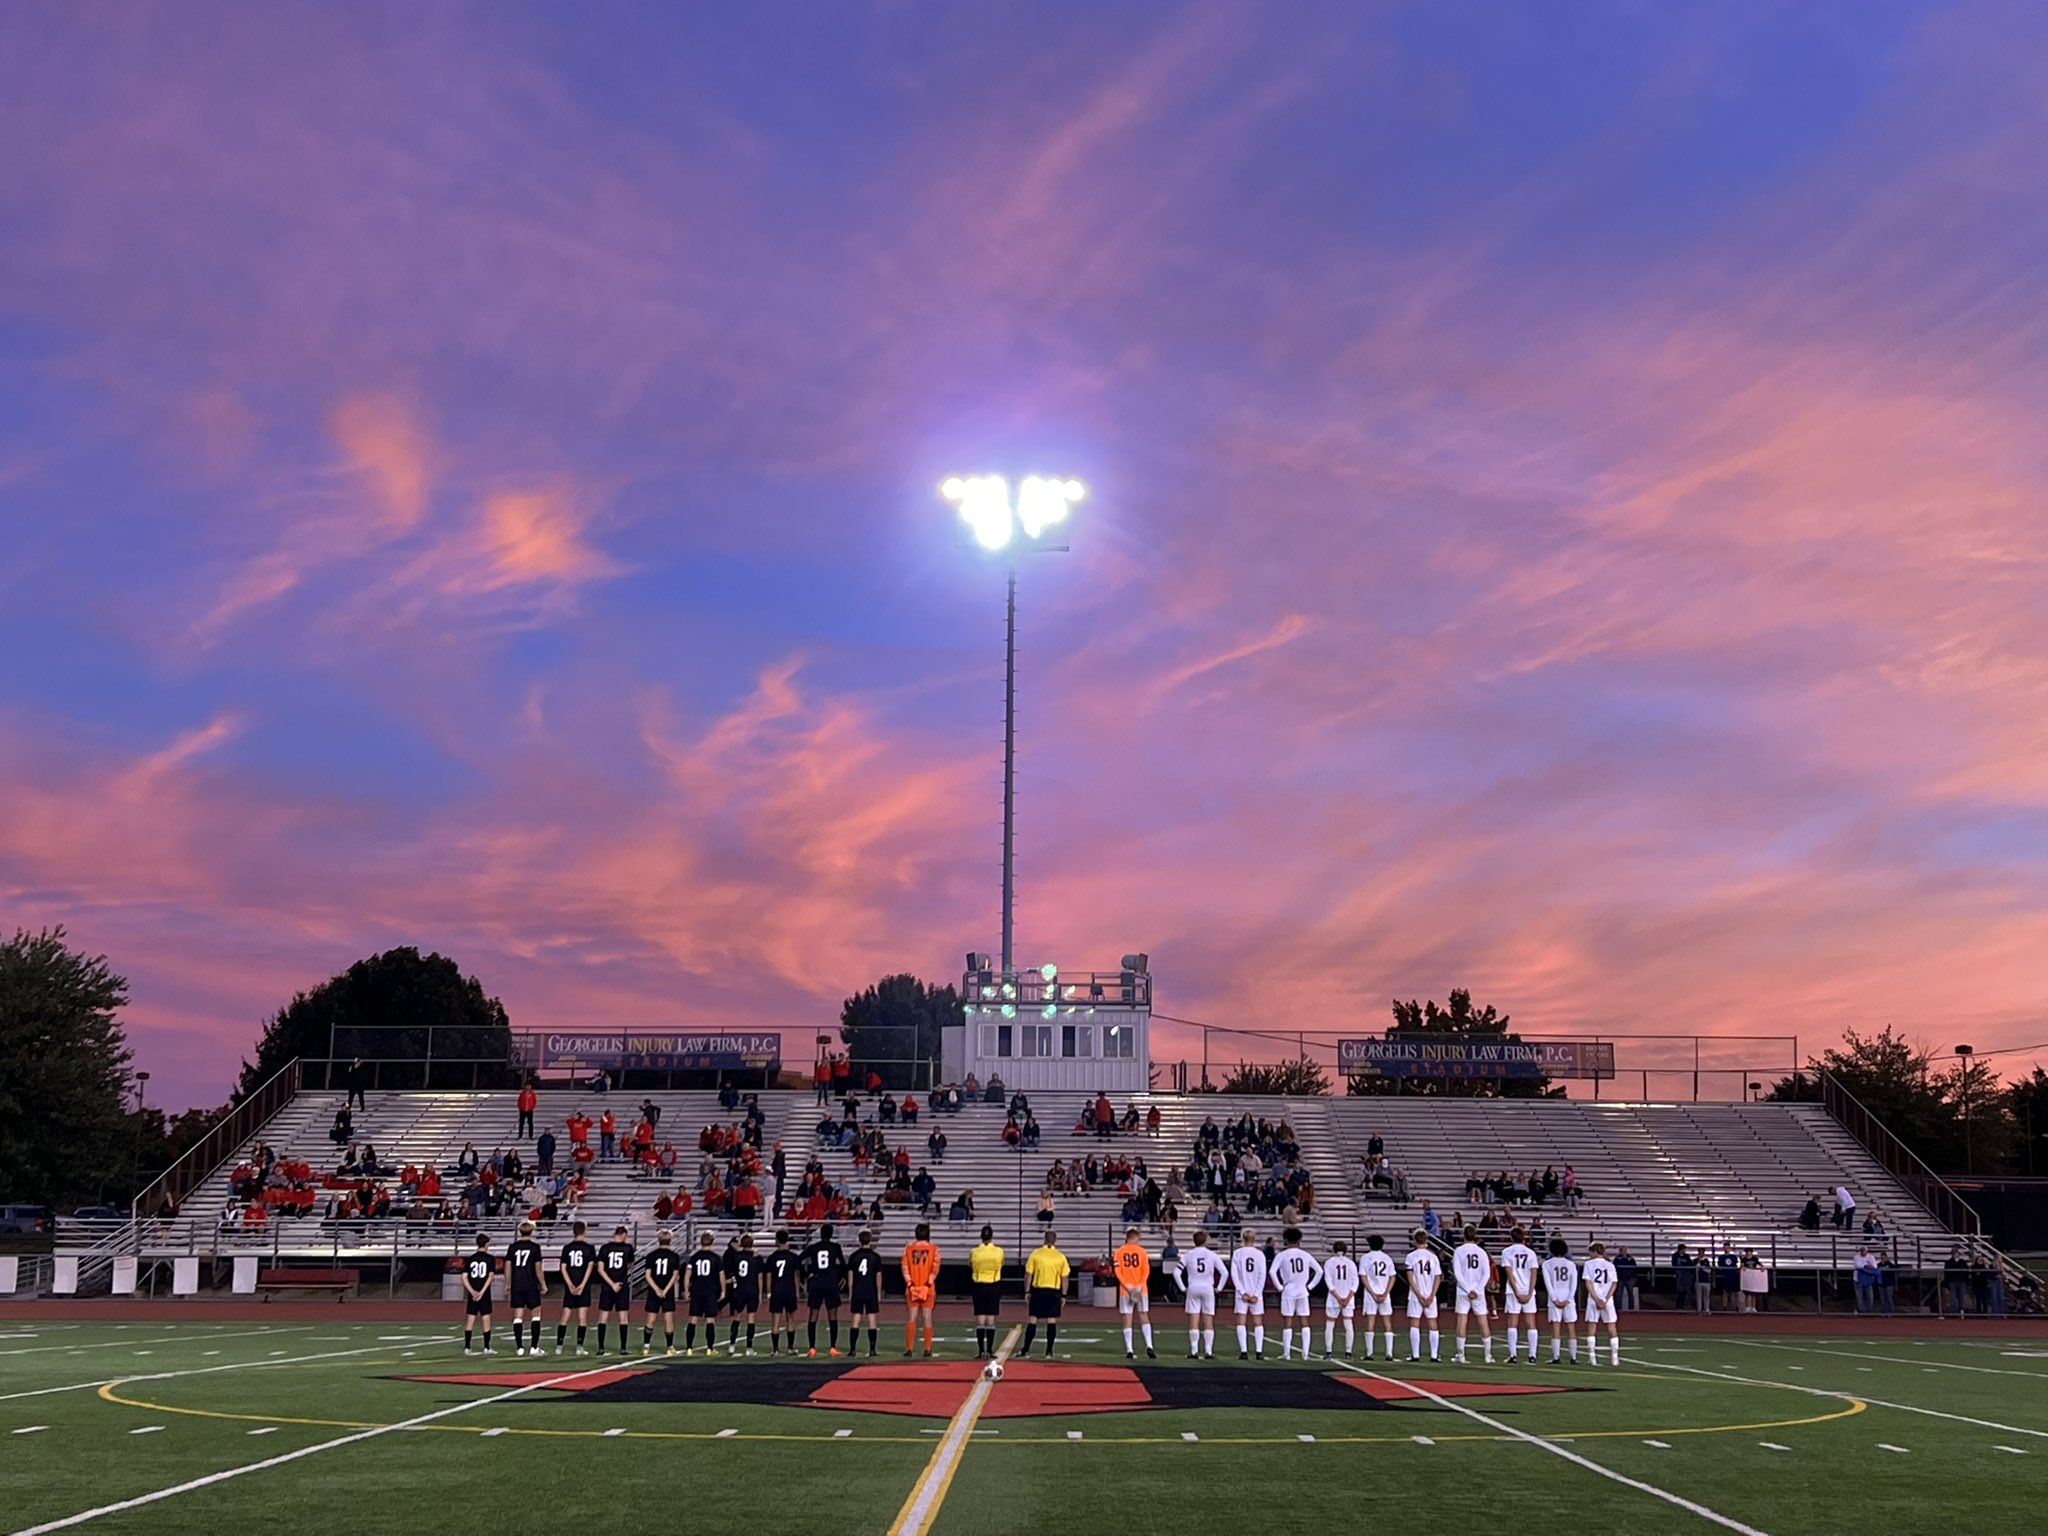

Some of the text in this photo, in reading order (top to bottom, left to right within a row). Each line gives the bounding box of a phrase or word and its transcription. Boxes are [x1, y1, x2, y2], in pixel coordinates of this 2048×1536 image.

[547, 1034, 777, 1056] GEORGELIS INJURY LAW FIRM, P.C.
[1341, 1041, 1573, 1063] GEORGELIS INJURY LAW FIRM, P.C.
[514, 1250, 531, 1267] 17
[569, 1250, 583, 1267] 16
[608, 1252, 624, 1268] 15
[655, 1258, 668, 1275] 11
[1123, 1253, 1140, 1268] 98
[1197, 1257, 1206, 1273] 5
[1245, 1257, 1255, 1273] 6
[1290, 1257, 1304, 1274] 10
[1466, 1254, 1479, 1269] 16
[1514, 1254, 1528, 1270] 17
[470, 1261, 487, 1278] 30
[695, 1259, 711, 1276] 10
[738, 1260, 749, 1277] 9
[776, 1260, 786, 1277] 7
[858, 1258, 868, 1276] 4
[1335, 1264, 1347, 1280] 11
[1373, 1261, 1387, 1277] 12
[1418, 1259, 1431, 1275] 14
[1553, 1266, 1568, 1282] 18
[1594, 1268, 1608, 1284] 21
